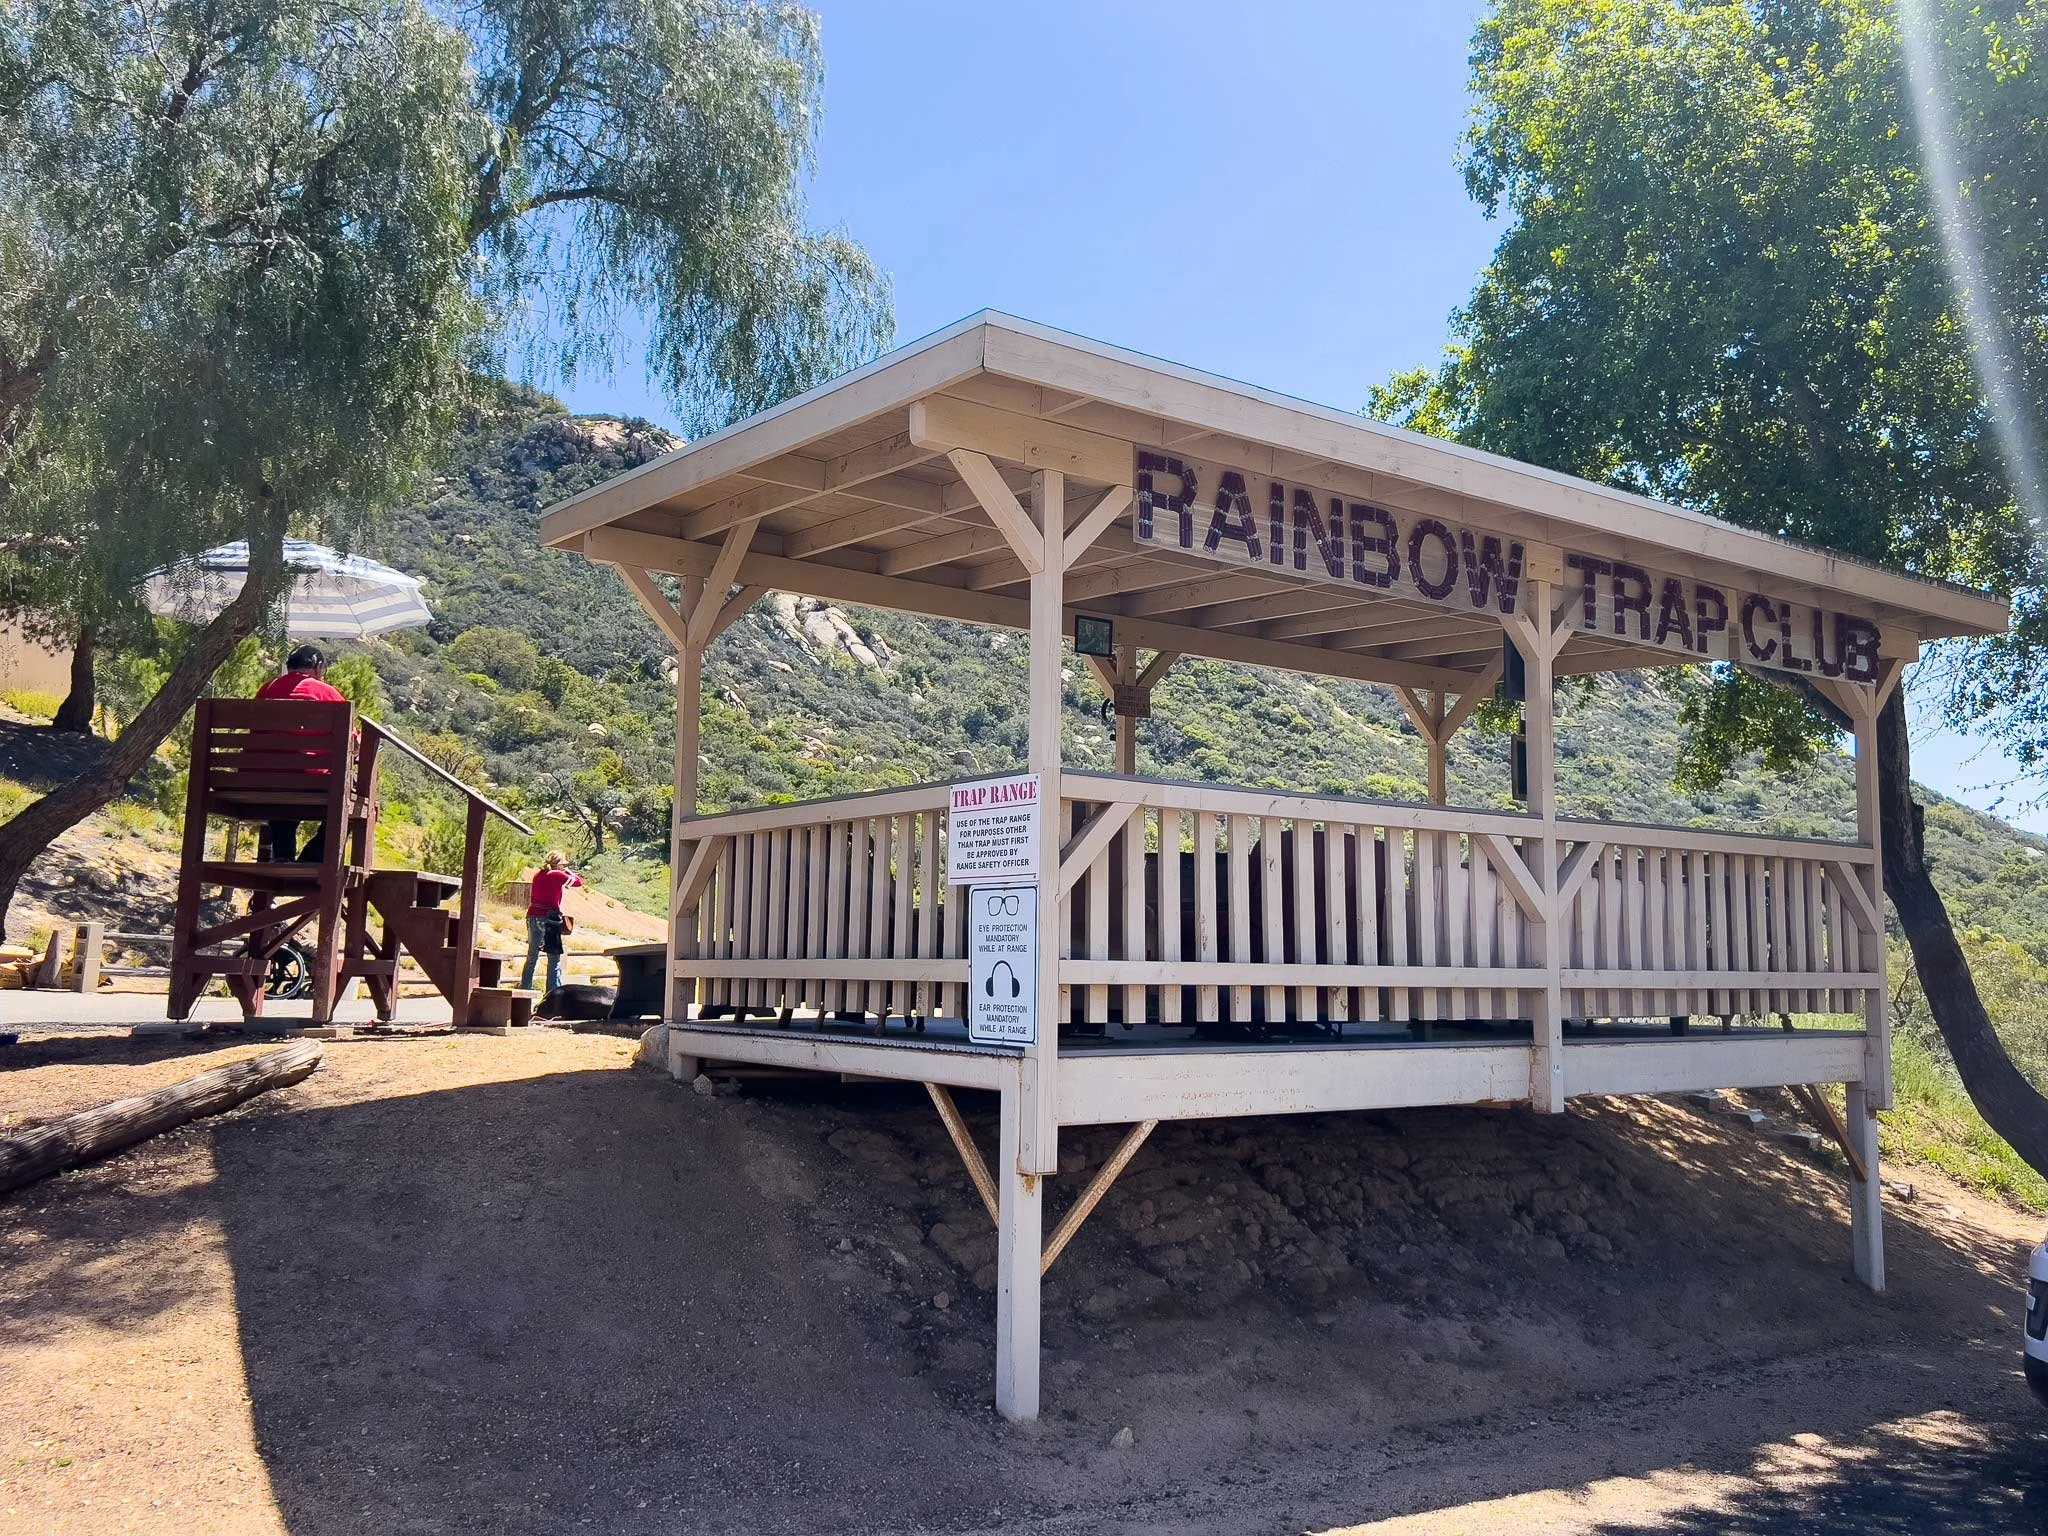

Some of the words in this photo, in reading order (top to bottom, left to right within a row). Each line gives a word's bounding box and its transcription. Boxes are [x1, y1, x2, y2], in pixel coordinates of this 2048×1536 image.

[1137, 450, 1524, 614] RAINBOW
[1568, 553, 1729, 653] TRAP
[1741, 593, 1882, 683] CLUB
[953, 787, 986, 807] TRAP
[990, 781, 1037, 803] RANGE
[992, 816, 1007, 824] TRAP
[1009, 814, 1031, 823] RANGE
[960, 830, 971, 838] FOR
[973, 828, 1004, 837] PURPOSES
[1006, 825, 1026, 834] OTHER
[975, 840, 990, 848] TRAP
[992, 838, 1009, 846] MUST
[1011, 836, 1029, 845] FIRST
[976, 850, 1008, 858] APPROVED
[1010, 848, 1018, 856] BY
[957, 862, 976, 870] RANGE
[978, 861, 1000, 869] SAFETY
[1003, 859, 1029, 867] OFFICER
[992, 924, 1028, 932] PROTECTION
[993, 1004, 1028, 1013] PROTECTION
[987, 1014, 1019, 1023] MANDATORY
[979, 1024, 996, 1033] WHILE
[999, 1025, 1005, 1033] AT
[1008, 1026, 1027, 1034] RANGE
